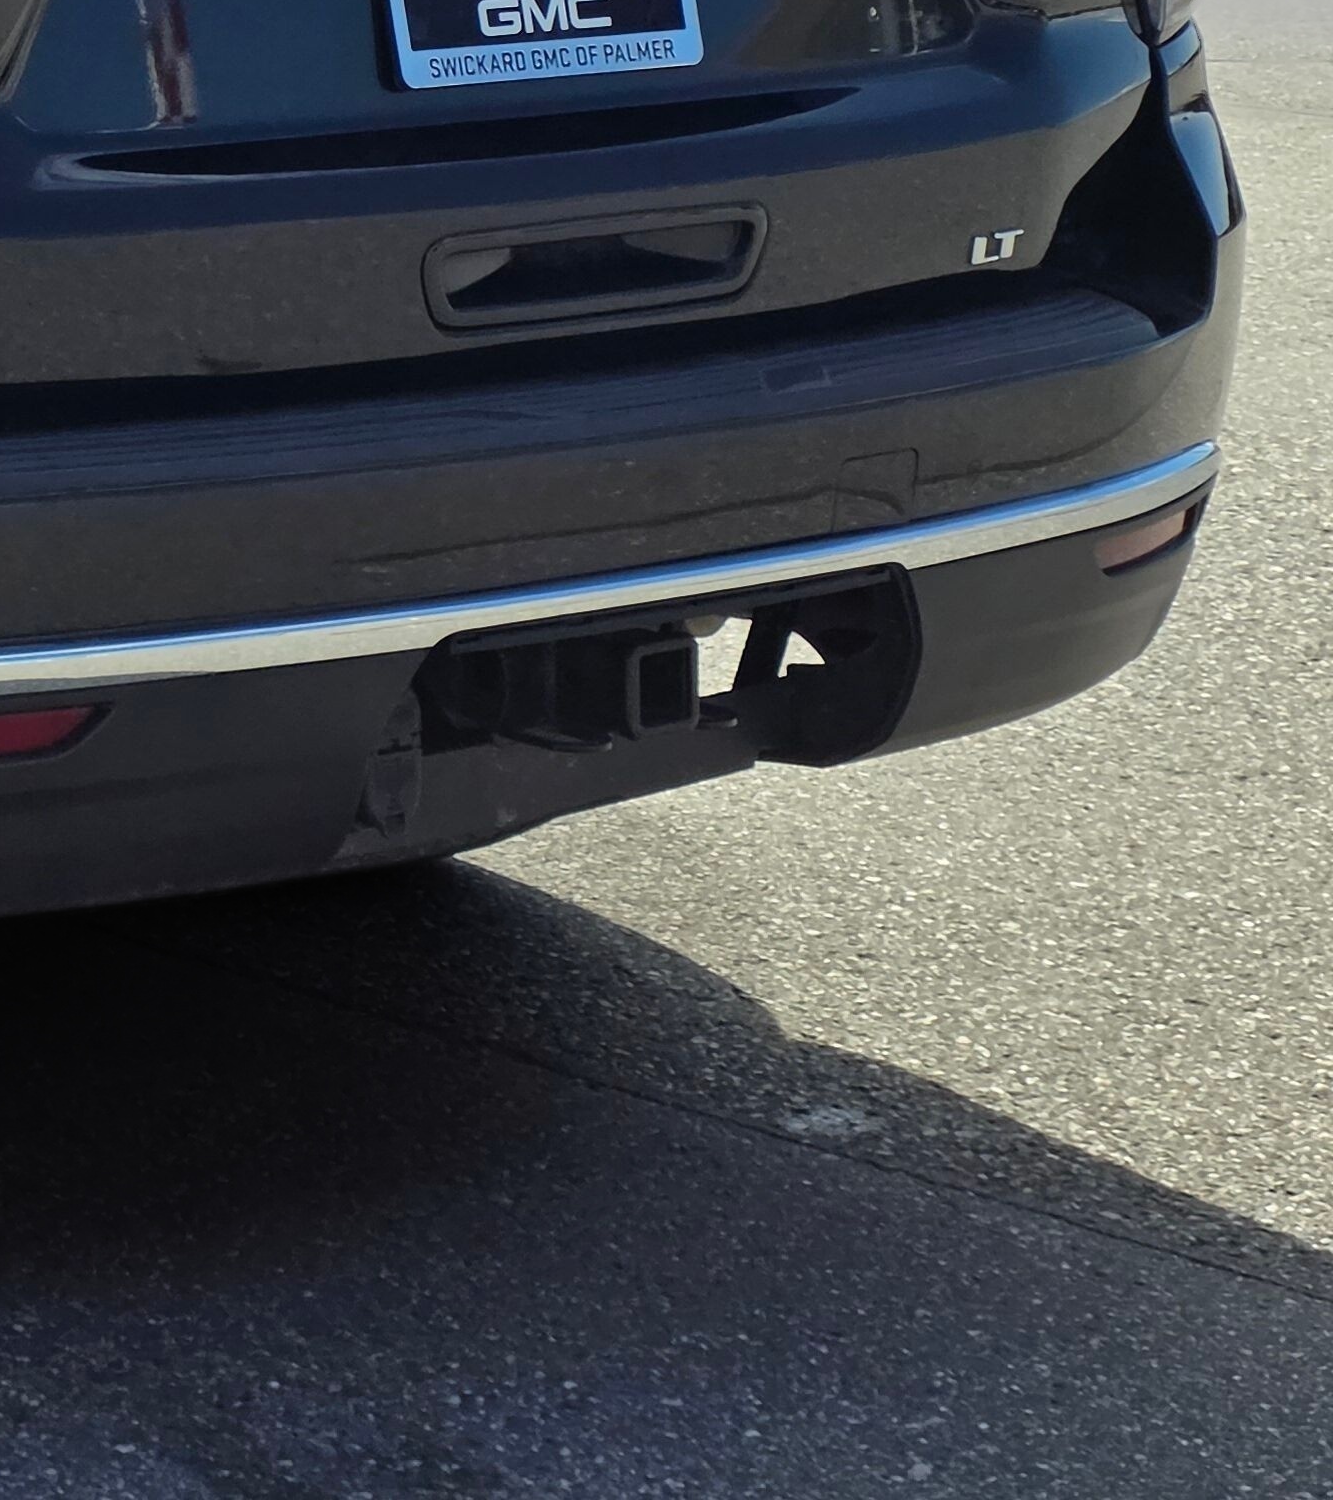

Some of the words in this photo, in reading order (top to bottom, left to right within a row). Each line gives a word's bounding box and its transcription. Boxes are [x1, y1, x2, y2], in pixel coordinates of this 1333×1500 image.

[429, 53, 527, 79] SWICKARD
[532, 48, 571, 71] GMC
[576, 44, 599, 66] OF
[604, 39, 676, 65] PALMER
[971, 228, 1025, 266] LT
